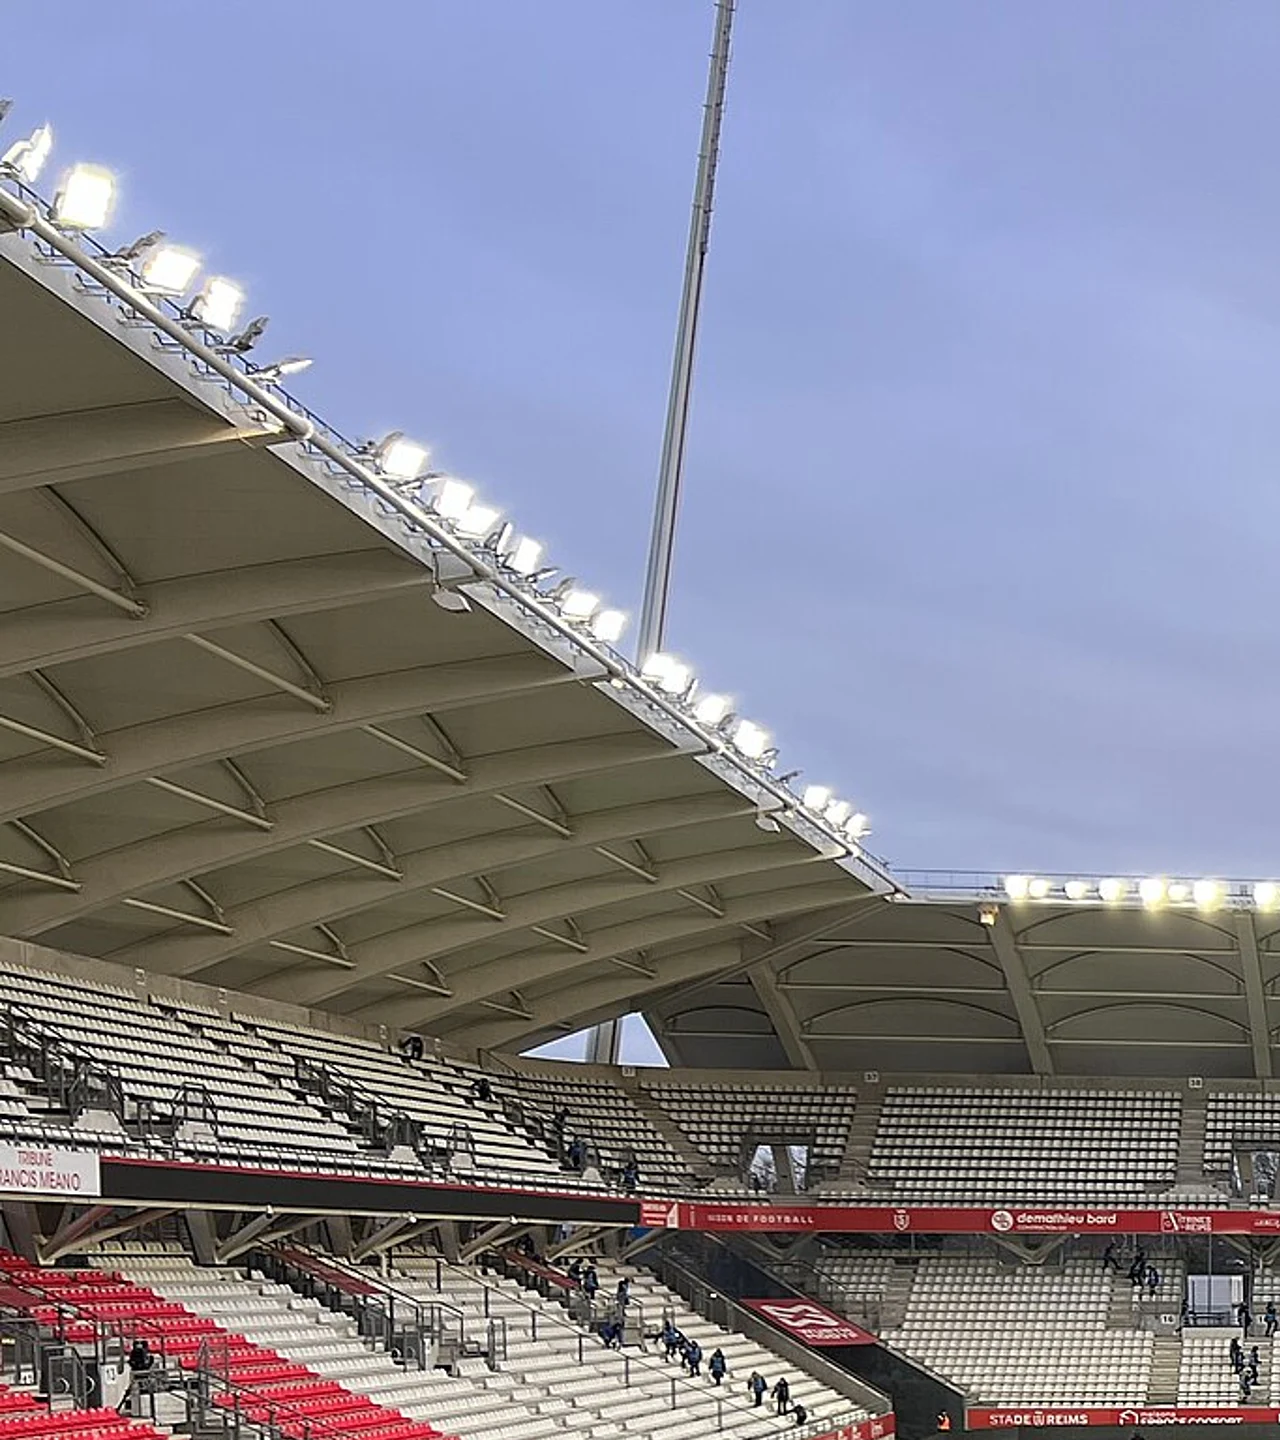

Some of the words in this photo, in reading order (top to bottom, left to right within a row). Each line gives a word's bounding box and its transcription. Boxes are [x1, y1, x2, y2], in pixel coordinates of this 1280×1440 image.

[17, 1151, 53, 1167] TRIBUNE
[0, 1169, 38, 1188] ANCIS
[40, 1171, 80, 1191] MEANO
[752, 1214, 815, 1225] FOOTBALL
[1017, 1213, 1085, 1224] demathieu
[1086, 1213, 1117, 1224] bard
[989, 1413, 1032, 1425] STADE
[1047, 1413, 1089, 1425] REIMS
